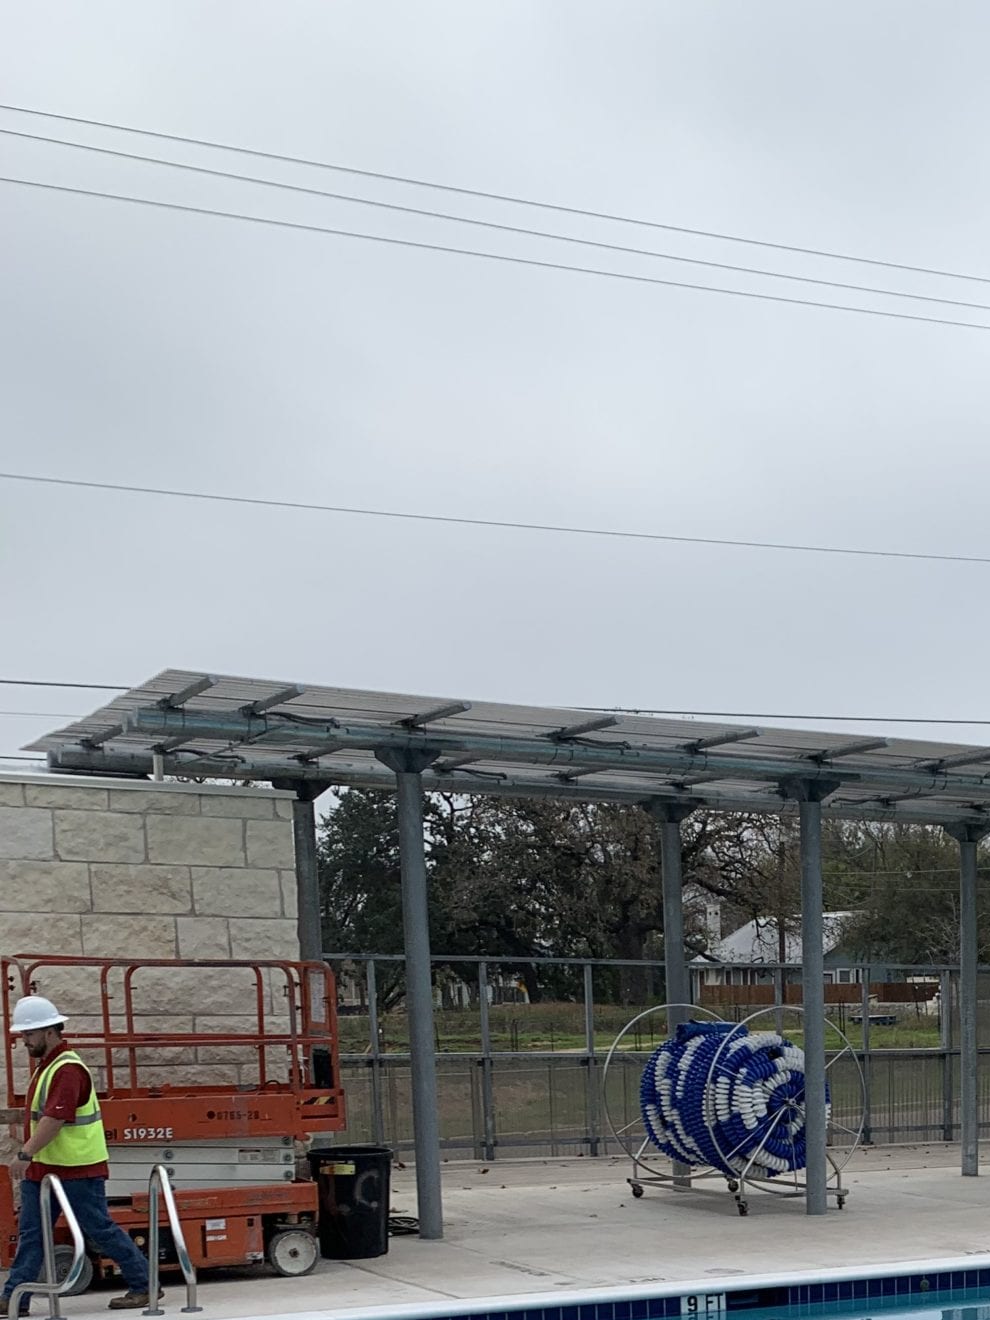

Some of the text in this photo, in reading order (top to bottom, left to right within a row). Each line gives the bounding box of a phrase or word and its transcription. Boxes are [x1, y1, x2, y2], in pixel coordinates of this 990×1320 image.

[123, 1127, 174, 1140] S1932E
[687, 1293, 724, 1313] 9 FT
